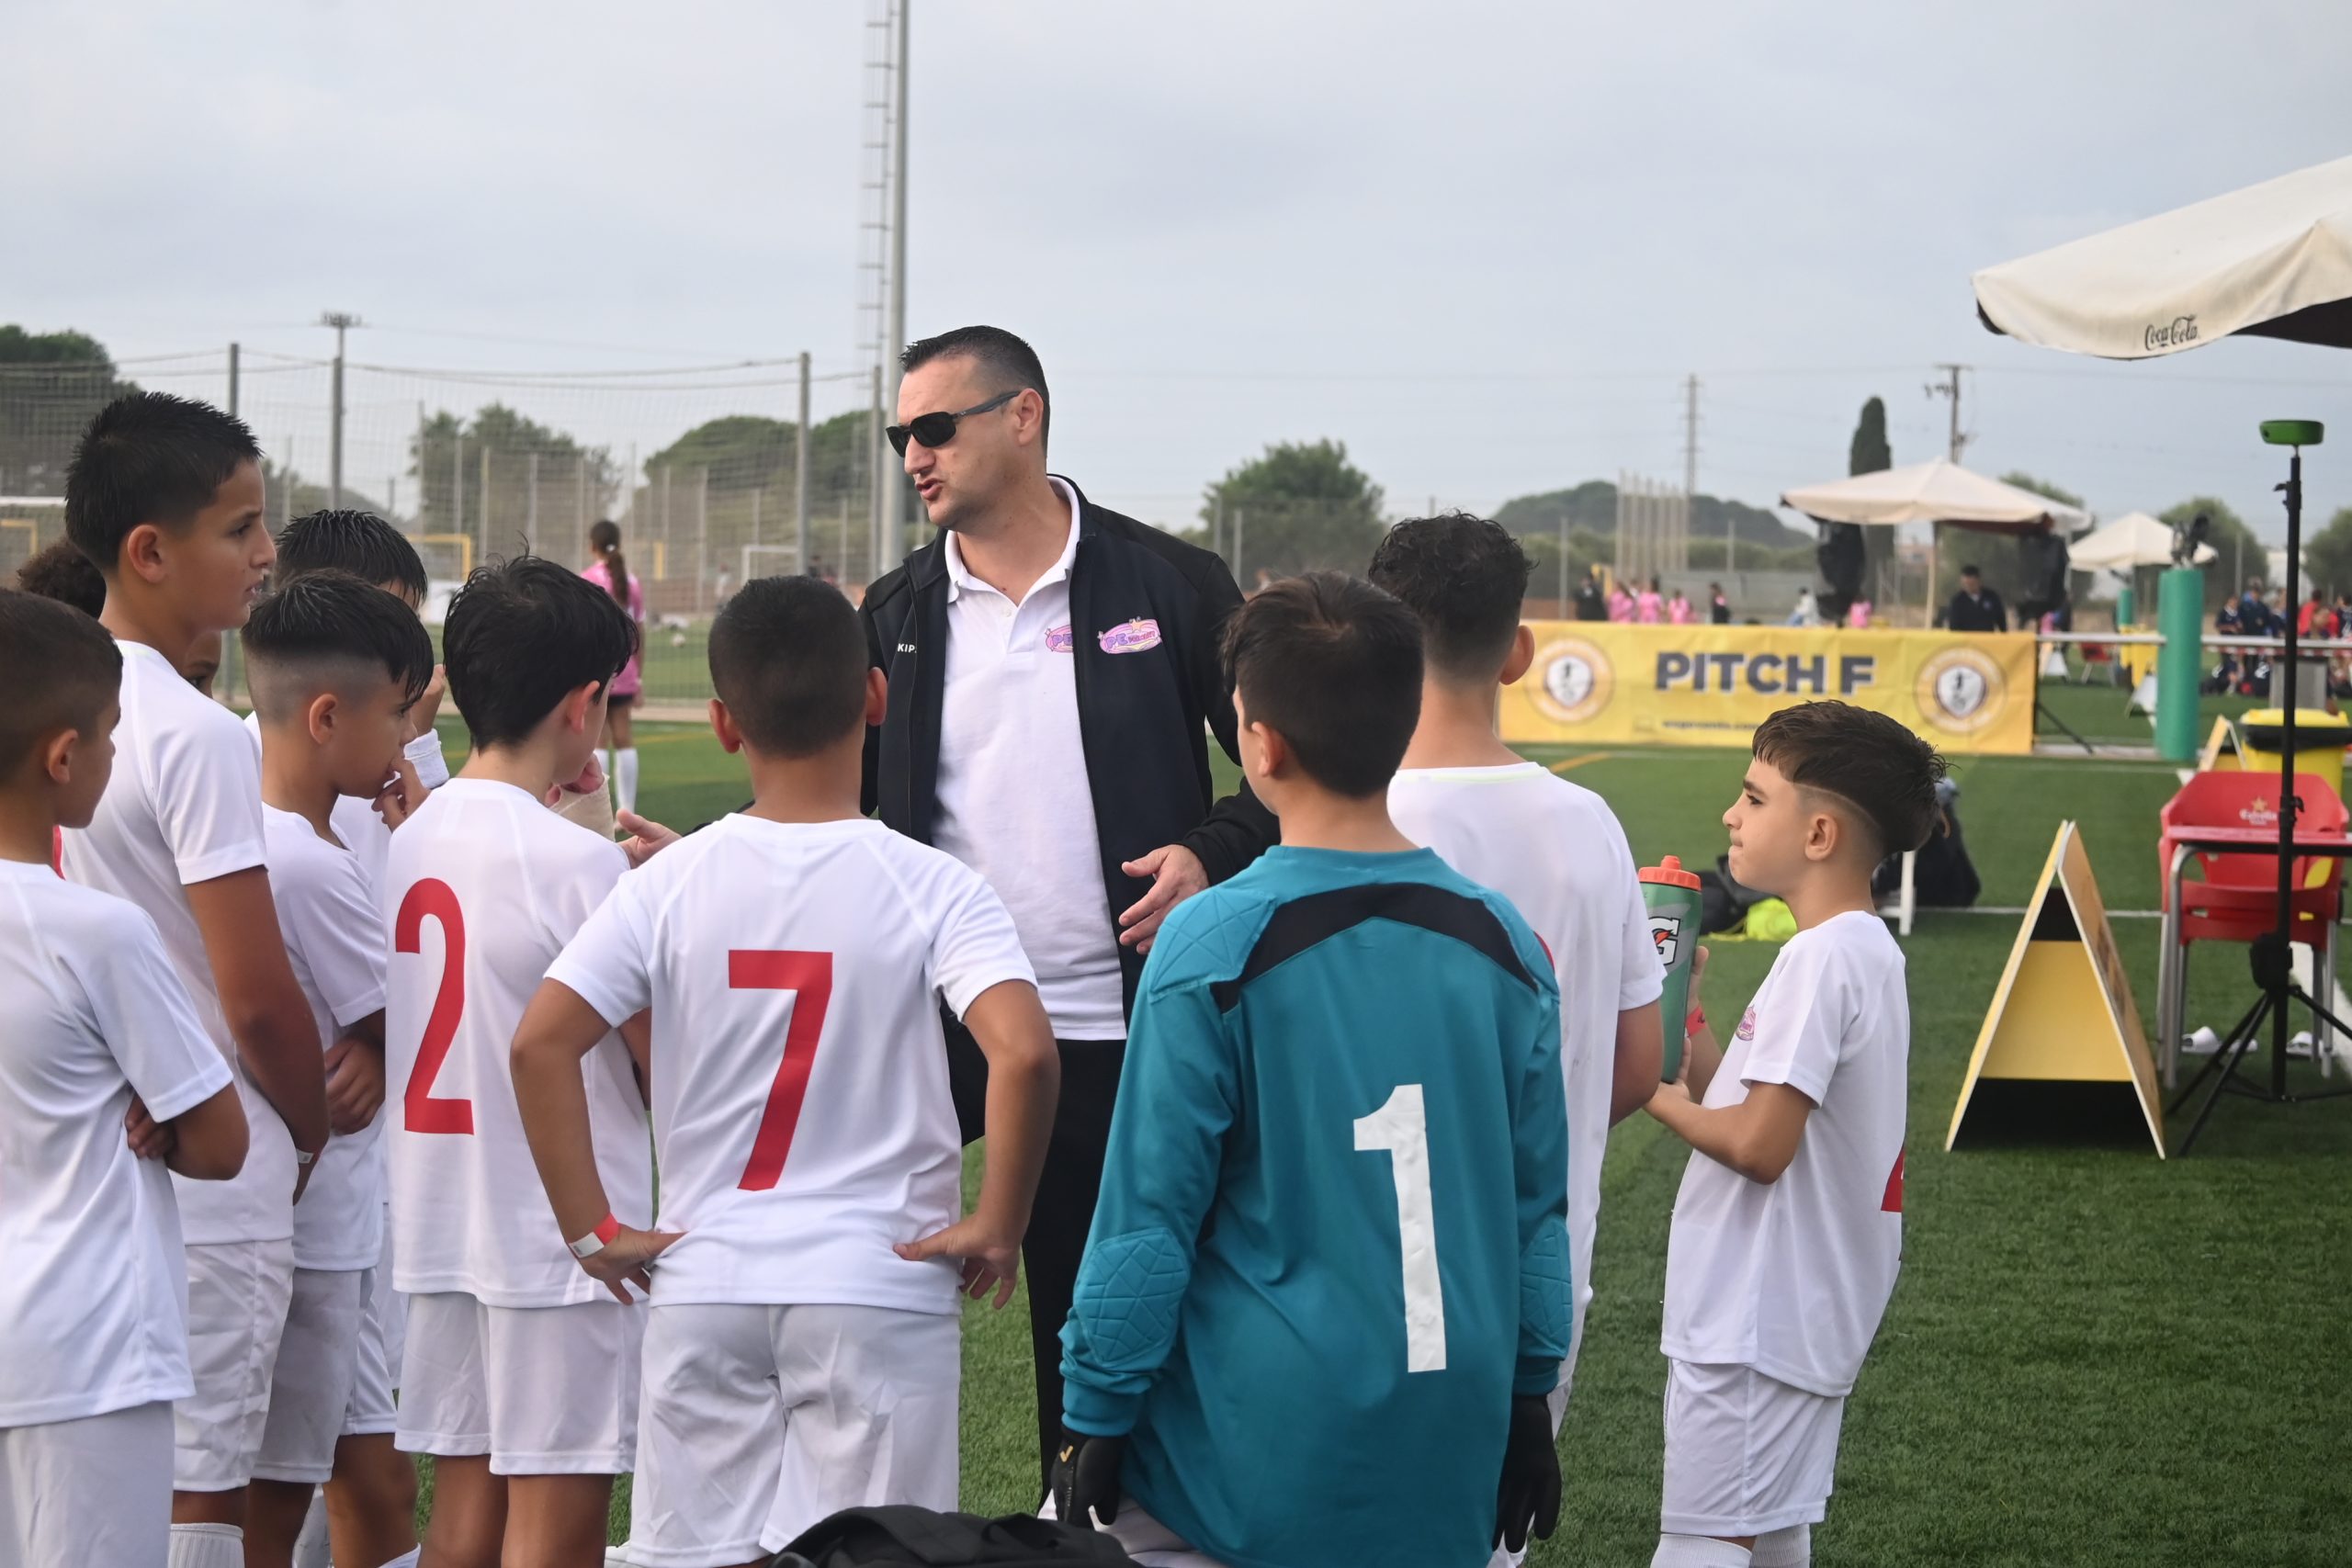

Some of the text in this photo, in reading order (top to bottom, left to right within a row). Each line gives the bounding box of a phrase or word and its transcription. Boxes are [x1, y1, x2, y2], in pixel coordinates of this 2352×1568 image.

[897, 643, 917, 654] KIP
[1105, 633, 1128, 649] PE
[1656, 651, 1826, 695] PITCH
[1840, 655, 1876, 696] F
[395, 877, 475, 1136] 2
[728, 949, 833, 1190] 7
[1352, 1083, 1447, 1373] 1
